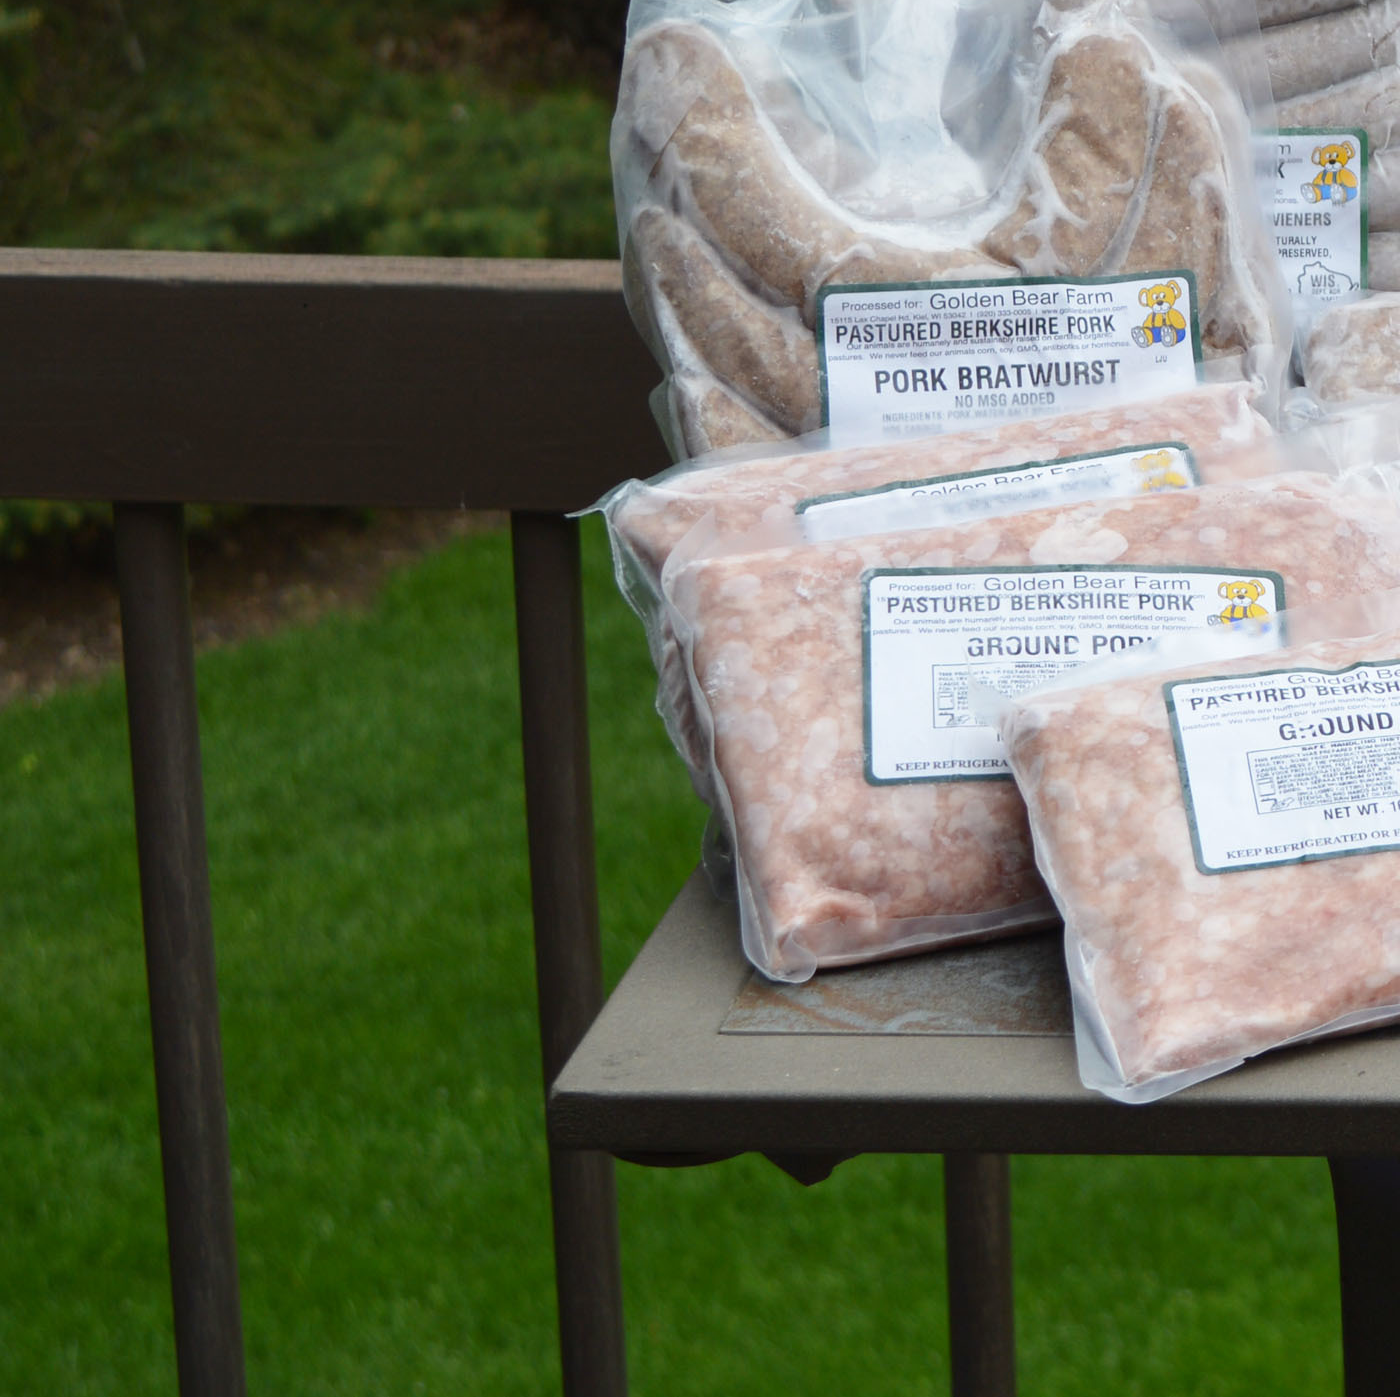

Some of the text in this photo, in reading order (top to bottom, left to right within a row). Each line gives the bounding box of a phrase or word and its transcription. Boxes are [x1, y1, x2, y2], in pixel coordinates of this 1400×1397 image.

[841, 288, 1114, 312] Processed for: Golden Bear Farm
[835, 314, 1116, 345] PASTURED BERKSHIRE PORK
[846, 342, 862, 351] Our
[869, 352, 884, 360] We
[909, 350, 928, 359] feed
[873, 359, 1121, 394] PORK BRATWURST
[954, 391, 1056, 409] NO MSG ADDED
[888, 575, 1191, 592] Processed Golden Bear Farm
[887, 593, 1195, 614] PASTURED BERKSHIRE PORK
[967, 635, 1081, 657] GROUND
[1191, 682, 1257, 694] Processed
[1286, 670, 1369, 686] Golden
[895, 758, 1009, 772] KEEP REFRIGERA
[1323, 806, 1352, 821] NET
[1357, 802, 1385, 817] WT.
[1226, 847, 1263, 861] KEEP
[1265, 831, 1368, 856] REFRIGERATED
[1370, 829, 1391, 840] OR
